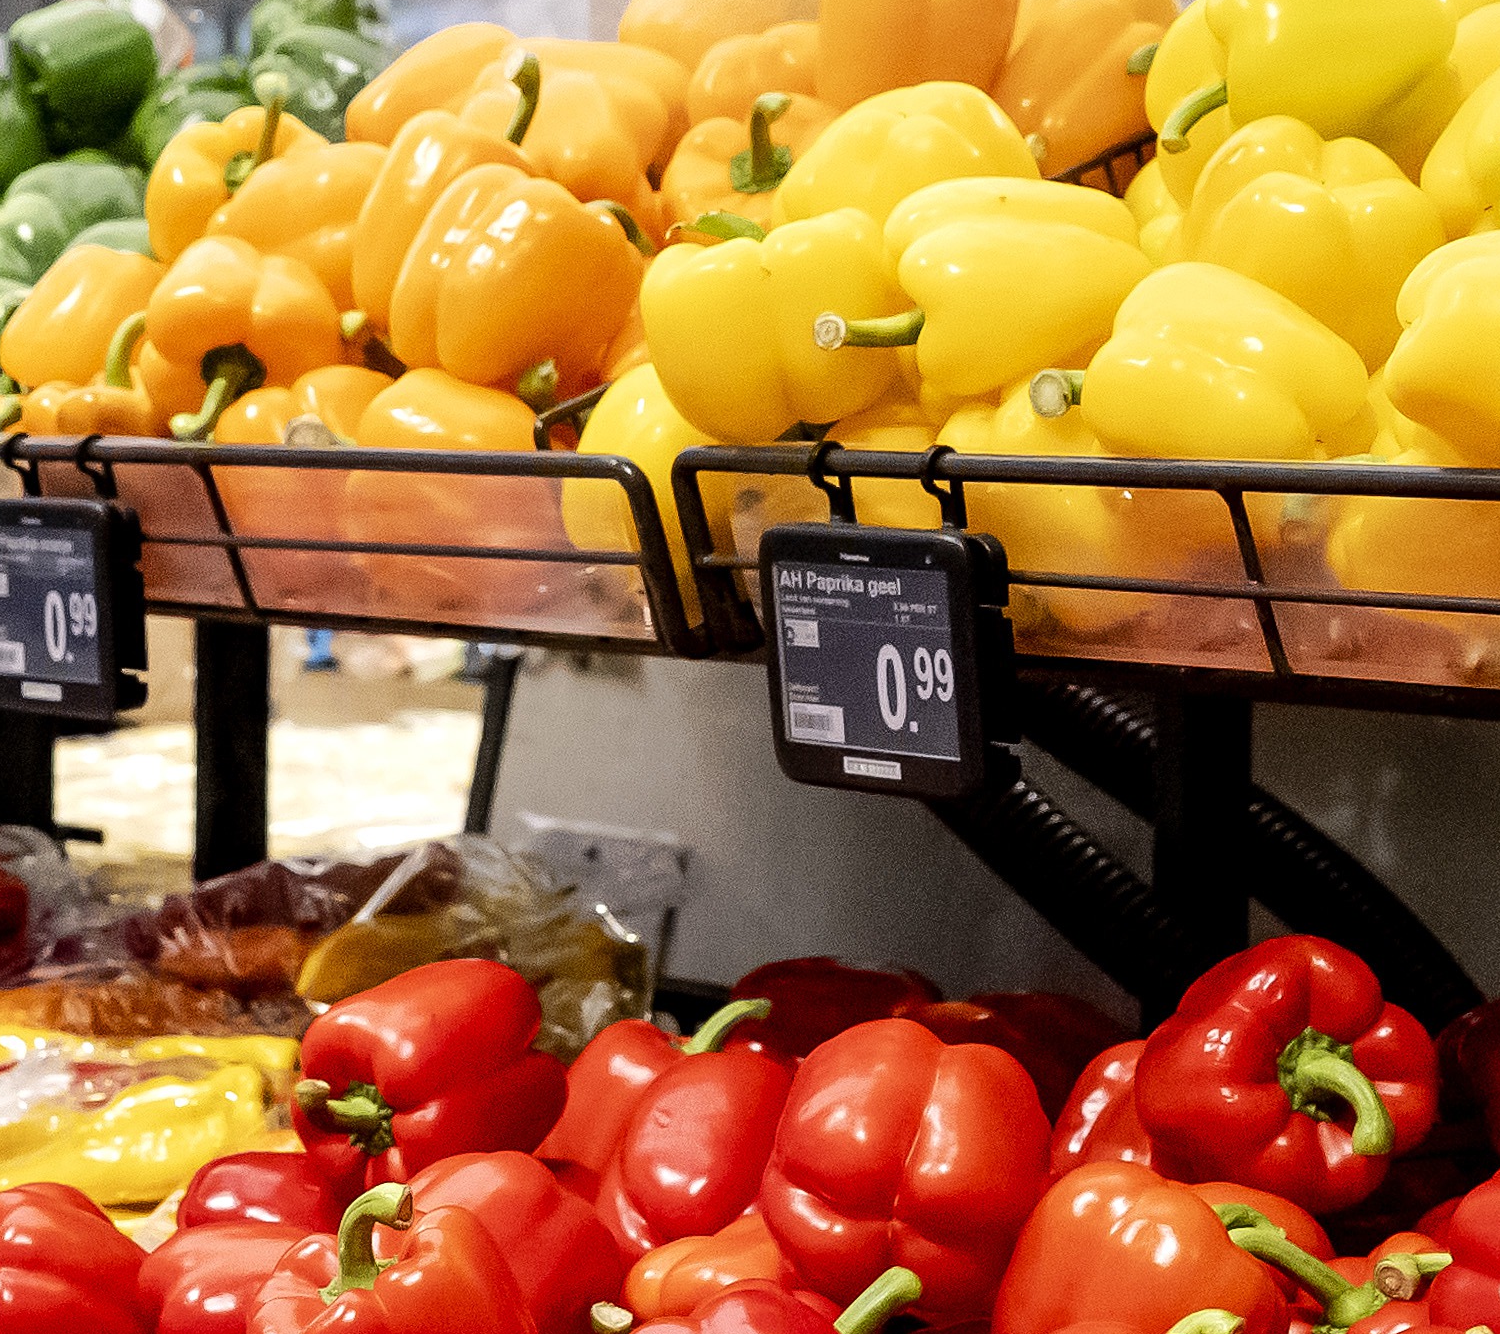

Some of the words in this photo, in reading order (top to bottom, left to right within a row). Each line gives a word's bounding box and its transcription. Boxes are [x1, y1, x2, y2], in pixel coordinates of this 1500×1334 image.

[779, 570, 802, 588] AH
[806, 570, 864, 595] Paprika
[868, 578, 901, 598] geel
[44, 589, 97, 662] 0.99
[876, 643, 954, 733] 0.99
